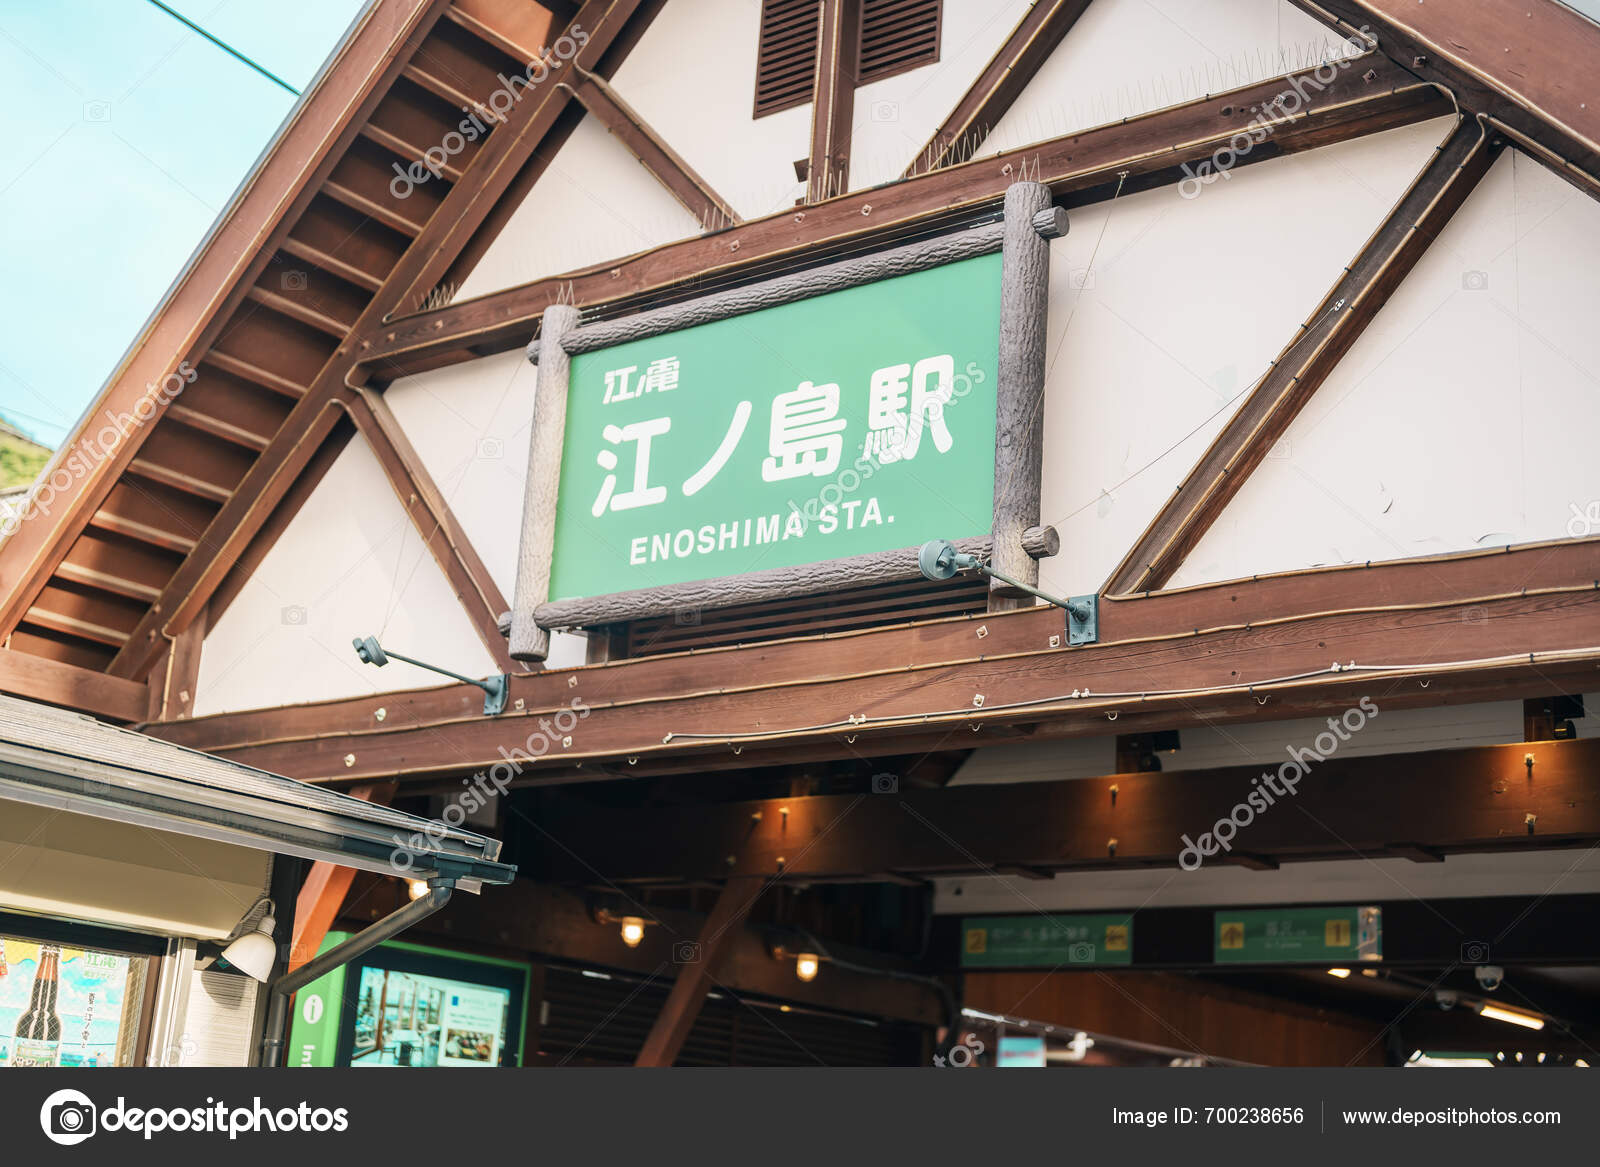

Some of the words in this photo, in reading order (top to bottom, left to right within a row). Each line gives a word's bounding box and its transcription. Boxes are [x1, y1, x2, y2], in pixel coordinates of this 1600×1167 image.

[592, 354, 954, 517] 江ノ島駅
[630, 511, 803, 565] ENOSHIMA
[818, 497, 895, 534] STA.
[301, 1045, 316, 1067] In
